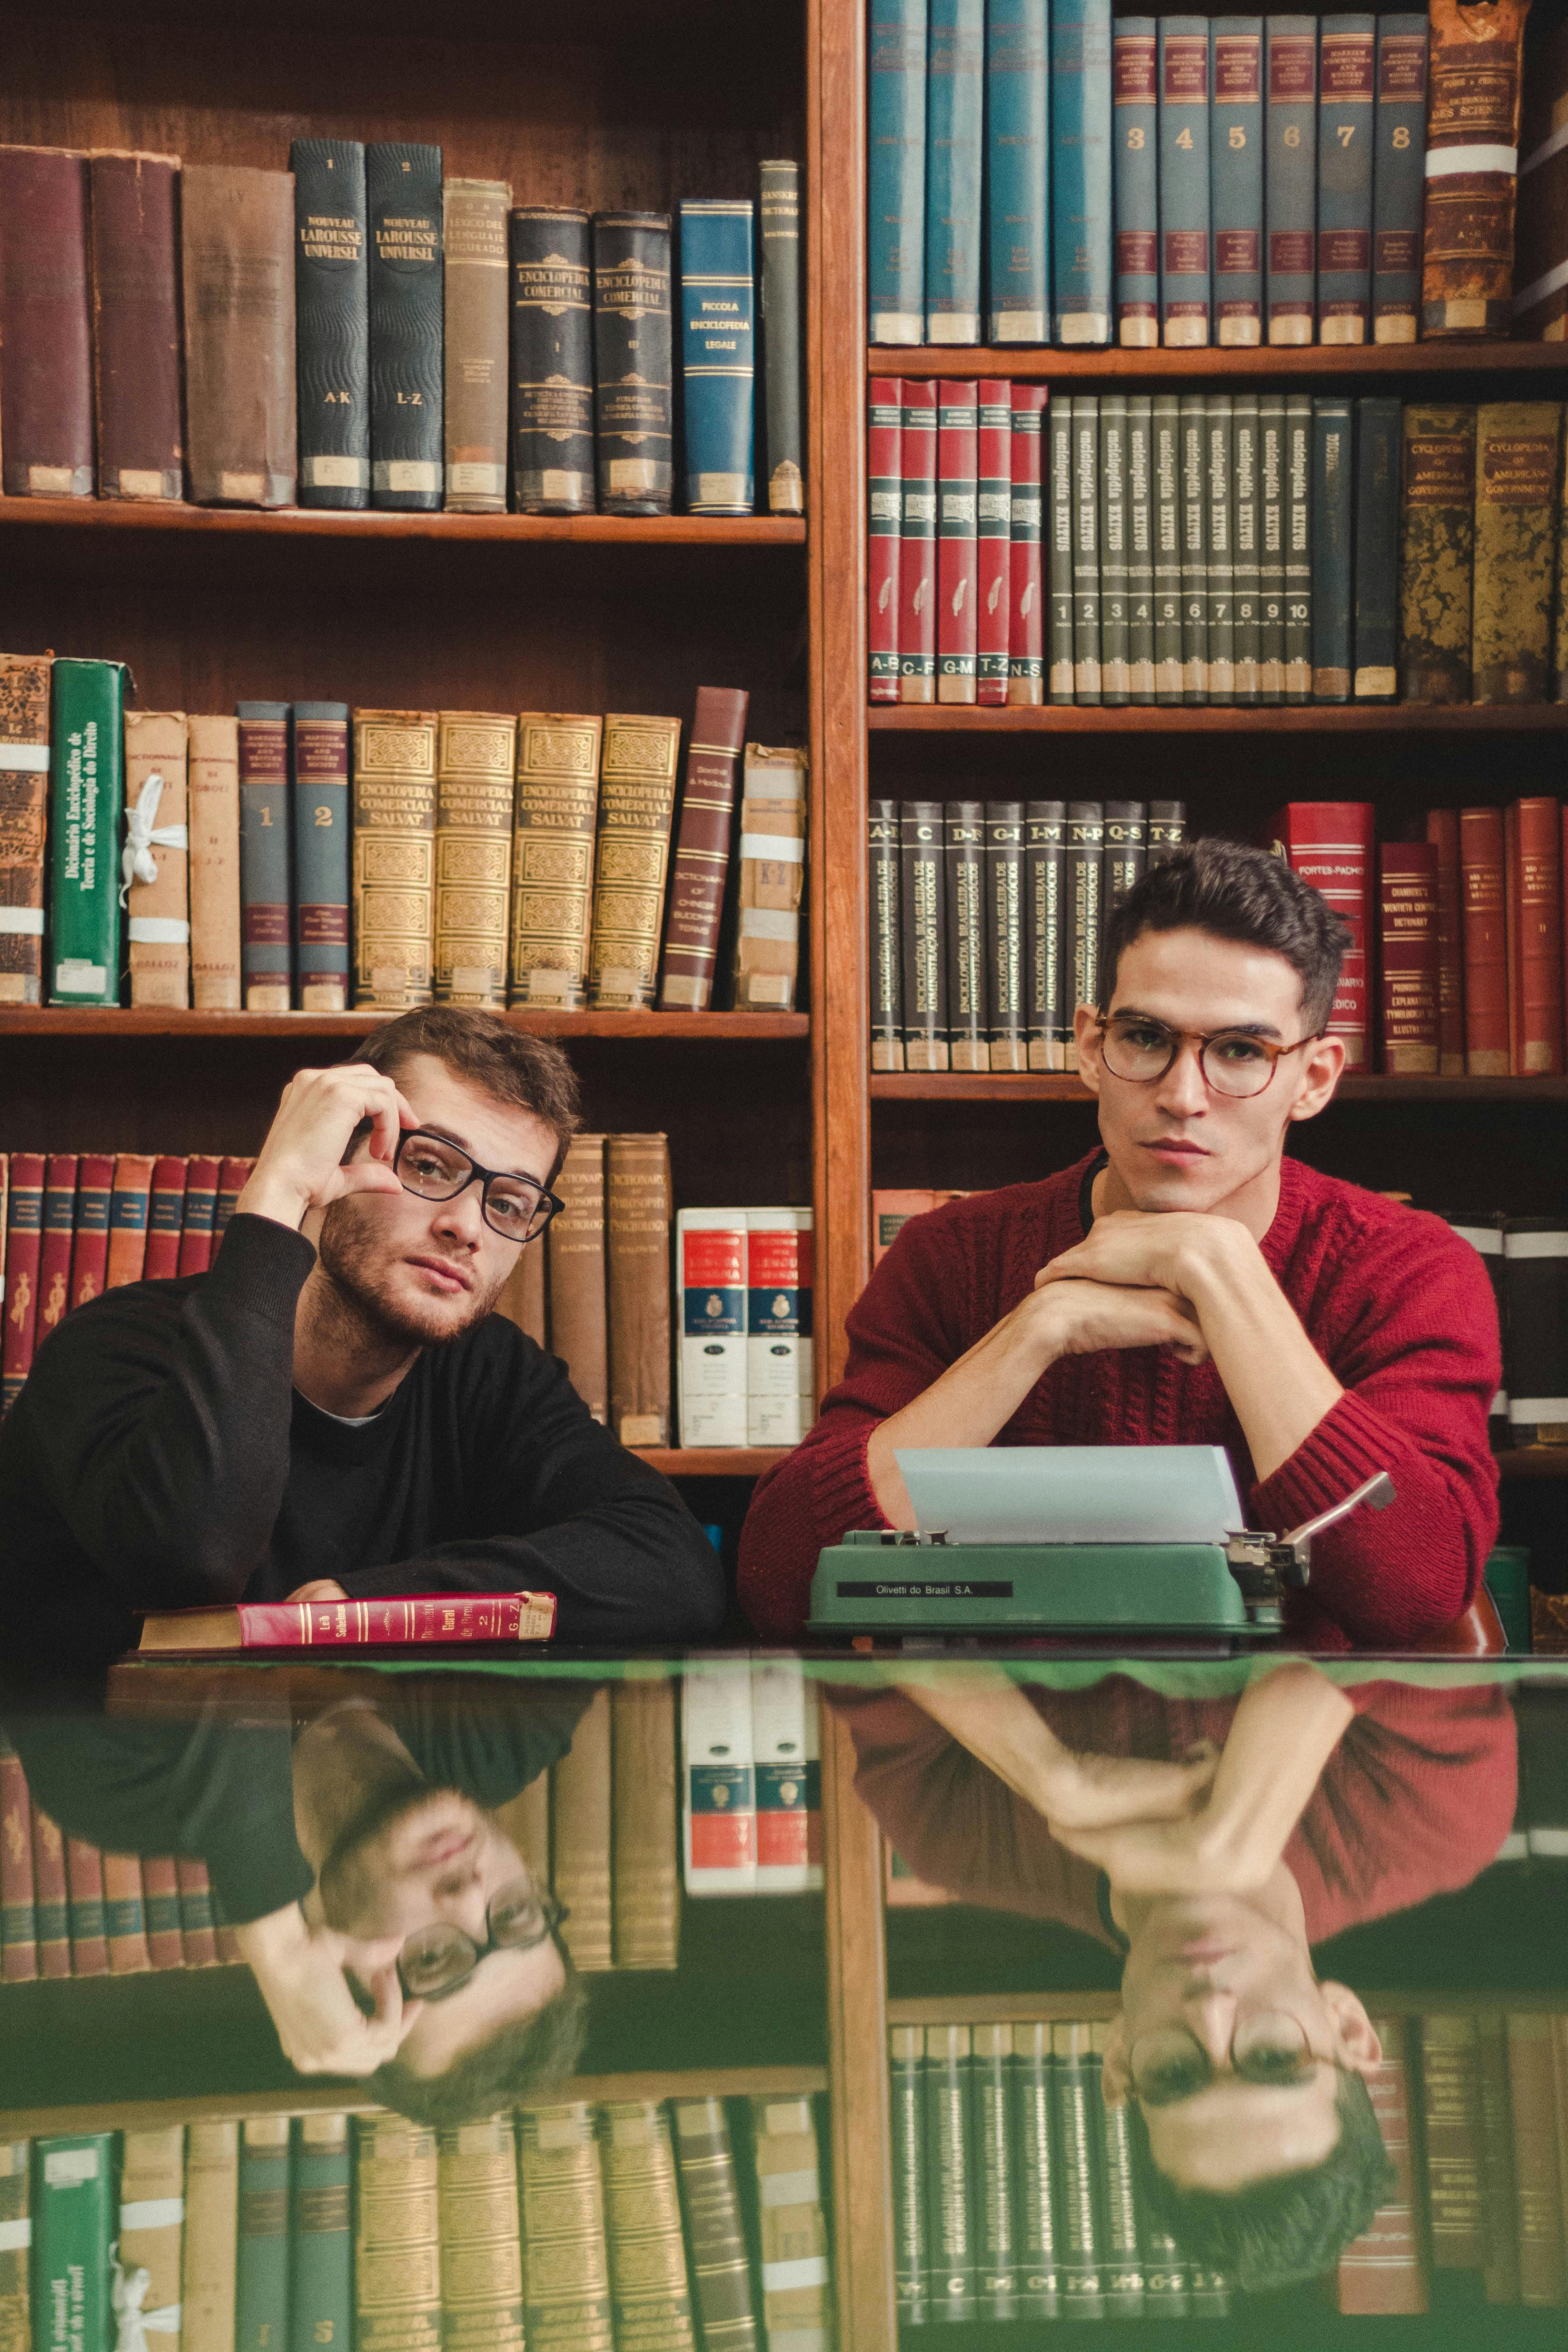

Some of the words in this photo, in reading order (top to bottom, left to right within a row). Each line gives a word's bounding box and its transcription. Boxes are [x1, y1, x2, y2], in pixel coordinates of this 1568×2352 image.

[1127, 127, 1145, 150] 3
[1175, 127, 1193, 149] 4
[1228, 126, 1247, 149] 5
[1283, 125, 1300, 148] 6
[1337, 126, 1356, 148] 7
[1391, 126, 1410, 149] 8
[327, 159, 334, 169] 1
[401, 161, 411, 171] 2
[308, 216, 355, 229] NOUVEAU
[383, 218, 431, 229] NOUVEAU
[301, 228, 362, 246] LAROUSSE
[376, 230, 438, 246] LAROUSSE
[305, 244, 359, 261] UNIVERSEL
[380, 246, 435, 261] UNIVERSEL
[449, 243, 505, 254] FIGURADO
[524, 286, 585, 300] COMERCIAL
[603, 291, 662, 305] COMERCIAL
[702, 302, 739, 312] PICCOLA
[690, 321, 750, 330] ENCICLOPEDIA
[705, 340, 738, 350] LEGALE
[324, 391, 351, 404] A-K
[397, 392, 423, 405] L-Z
[1055, 505, 1070, 552] EXITUS
[1080, 505, 1094, 552] EXITUS
[1108, 505, 1123, 551] EXITUS
[1133, 505, 1149, 551] EXITUS
[1160, 505, 1175, 551] EXITUS
[1186, 504, 1201, 550] EXITUS
[1211, 505, 1227, 551] EXITUS
[1239, 504, 1254, 550] EXITUS
[1265, 505, 1280, 551] EXITUS
[1292, 504, 1307, 551] EXITUS
[1058, 605, 1067, 619] 1
[1083, 604, 1094, 618] 2
[1111, 604, 1122, 618] 3
[1136, 604, 1148, 618] 4
[1163, 604, 1175, 618] 5
[1189, 603, 1201, 618] 6
[1215, 604, 1226, 618] 7
[1240, 604, 1252, 618] 8
[1267, 604, 1279, 618] 9
[1289, 604, 1308, 618] 10
[872, 657, 900, 671] A-B
[902, 662, 935, 675] C-F
[943, 662, 973, 675] G-M
[981, 657, 1009, 672] T-Z
[1011, 664, 1041, 677] N-S
[67, 732, 82, 746] de
[82, 721, 98, 758] Direito
[82, 761, 97, 775] do
[66, 749, 84, 820] Enciclopédico
[81, 777, 99, 830] Sociologia
[359, 798, 434, 813] COMERCIAL
[440, 798, 513, 814] COMERCIAL
[522, 798, 594, 815] COMERCIAL
[601, 798, 670, 814] COMERCIAL
[260, 806, 274, 827] 1
[314, 805, 333, 827] 2
[370, 811, 424, 826] SALVAT
[449, 811, 502, 826] SALVAT
[530, 813, 585, 828] SALVAT
[607, 812, 661, 827] SALVAT
[81, 832, 96, 845] de
[917, 826, 933, 840] C
[953, 828, 983, 841] D-F
[993, 828, 1021, 841] G-I
[1031, 826, 1061, 840] I-M
[1073, 826, 1103, 841] N-P
[1109, 826, 1142, 840] Q-S
[1151, 827, 1182, 842] T-Z
[64, 824, 80, 878] Dicionário
[80, 857, 95, 891] Teoria
[877, 860, 888, 874] DE
[914, 861, 924, 876] DE
[957, 862, 967, 876] DE
[996, 862, 1006, 877] DE
[1035, 861, 1045, 876] DE
[1075, 862, 1086, 876] DE
[925, 862, 936, 915] NEGÓCIOS
[968, 863, 979, 916] NEGÓCIOS
[1006, 862, 1018, 915] NEGÓCIOS
[1045, 861, 1057, 915] NEGÓCIOS
[1086, 862, 1098, 916] NEGÓCIOS
[878, 876, 889, 934] BRASILEIRA
[915, 877, 926, 935] BRASILEIRA
[958, 878, 969, 936] BRASILEIRA
[997, 878, 1008, 936] BRASILEIRA
[1035, 878, 1046, 935] BRASILEIRA
[1075, 878, 1087, 936] BRASILEIRA
[1074, 940, 1086, 1005] NCICLOPÉDIA
[1085, 928, 1098, 1004] DMINISTRAÇÃO
[879, 938, 891, 1012] ENCICLOPÉDIA
[915, 938, 926, 1012] ENCICLOPÉDIA
[958, 940, 970, 1013] ENCICLOPÉDIA
[997, 940, 1009, 1013] ENCICLOPÉDIA
[1033, 939, 1045, 1012] ENCICLOPÉDIA
[876, 1585, 906, 1595] Olivetti
[910, 1586, 921, 1595] do
[925, 1585, 950, 1595] Brasil
[954, 1586, 973, 1595] S.A.
[319, 1615, 330, 1630] Leib
[336, 1604, 347, 1637] Soibelman
[442, 1609, 455, 1630] Geral
[478, 1615, 488, 1626] 2
